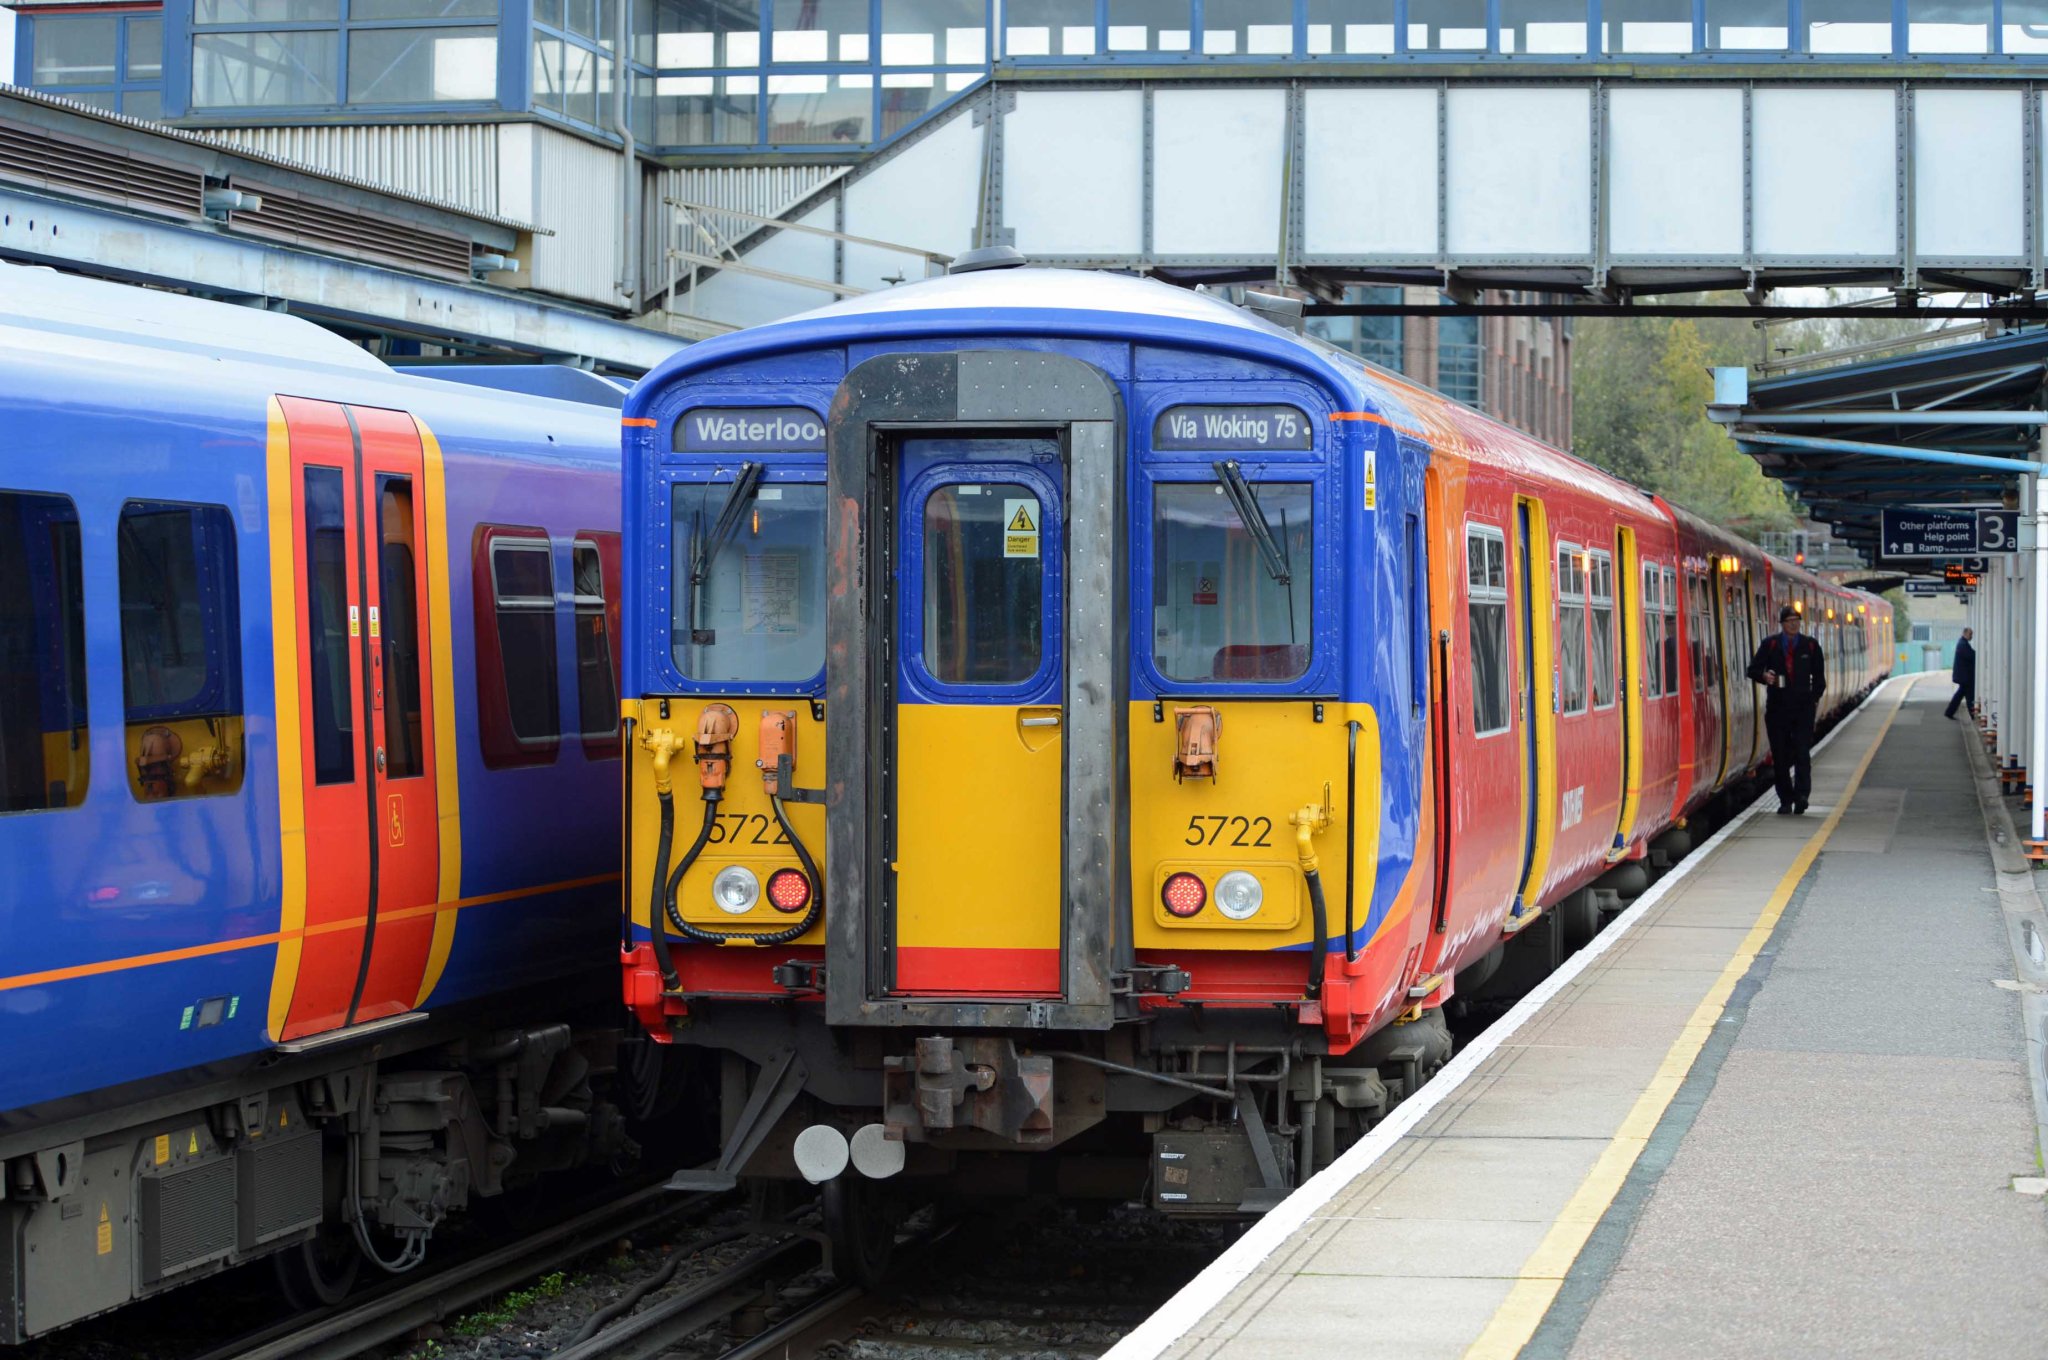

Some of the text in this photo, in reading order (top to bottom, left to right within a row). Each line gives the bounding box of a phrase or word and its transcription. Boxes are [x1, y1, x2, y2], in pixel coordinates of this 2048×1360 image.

[696, 417, 819, 441] Waterloo
[1170, 414, 1297, 444] Via Woking 75
[1900, 520, 1970, 532] Other platforms
[1007, 535, 1031, 543] Danger
[1924, 532, 1970, 542] Help point
[1919, 543, 1944, 553] Ramp
[1185, 815, 1272, 847] 5722
